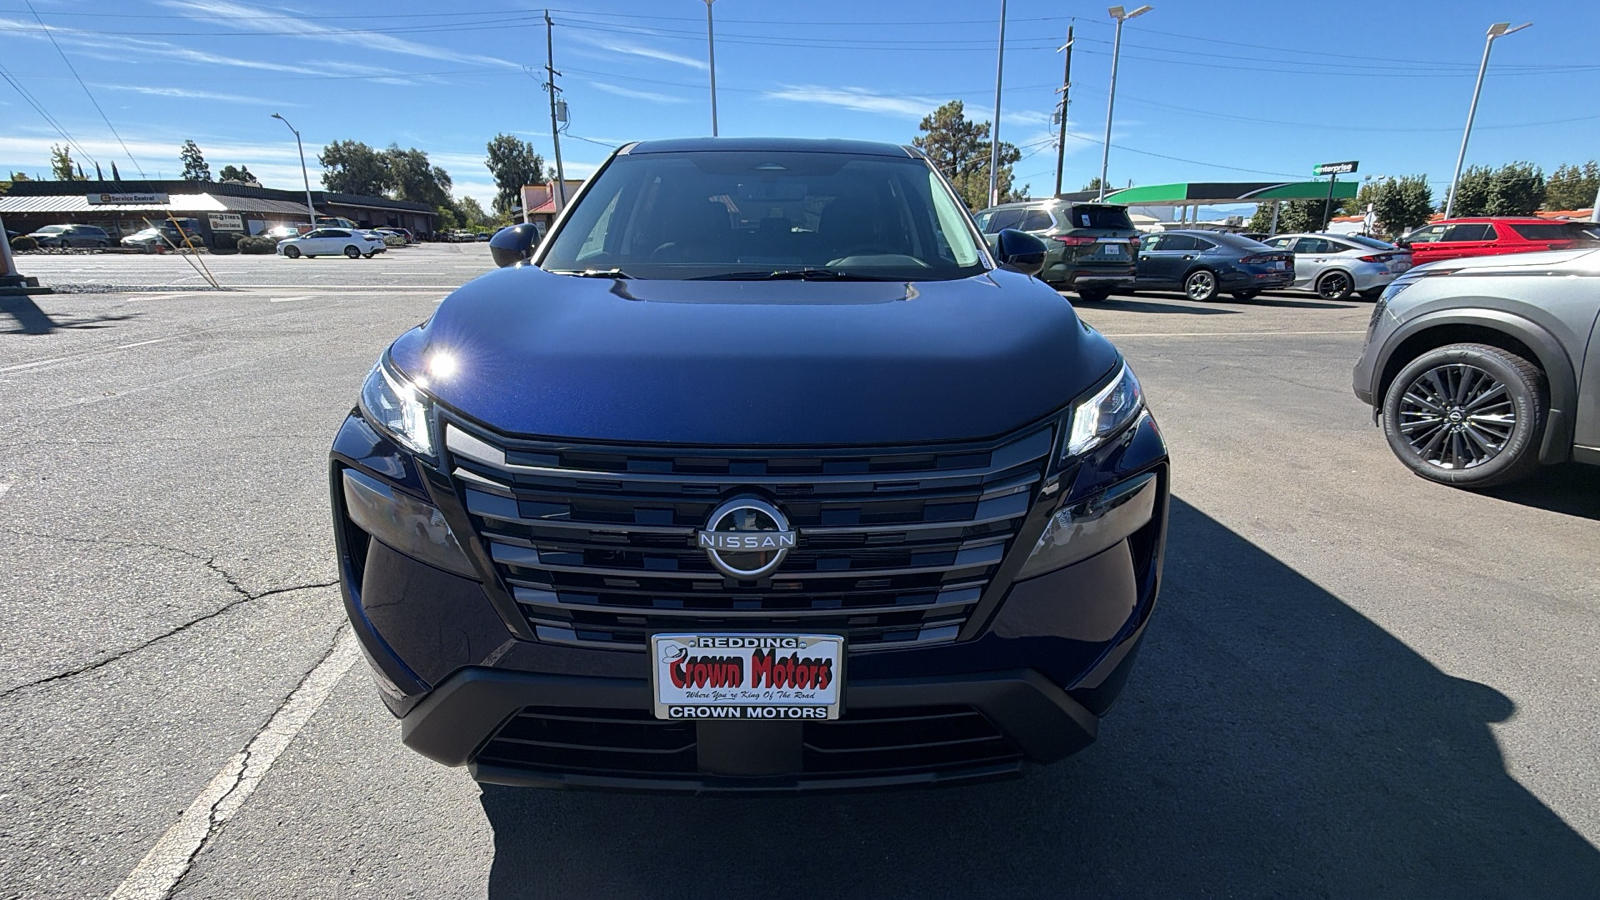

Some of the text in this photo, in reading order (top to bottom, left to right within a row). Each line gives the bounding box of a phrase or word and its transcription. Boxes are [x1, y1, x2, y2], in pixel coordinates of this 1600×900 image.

[1315, 164, 1353, 173] enterprise
[701, 533, 794, 548] NISSAN
[699, 638, 797, 648] REDDING
[669, 648, 833, 690] Crown Motors
[686, 690, 815, 701] Where You're King Of The Road
[670, 707, 827, 719] CROWN MOTORS
